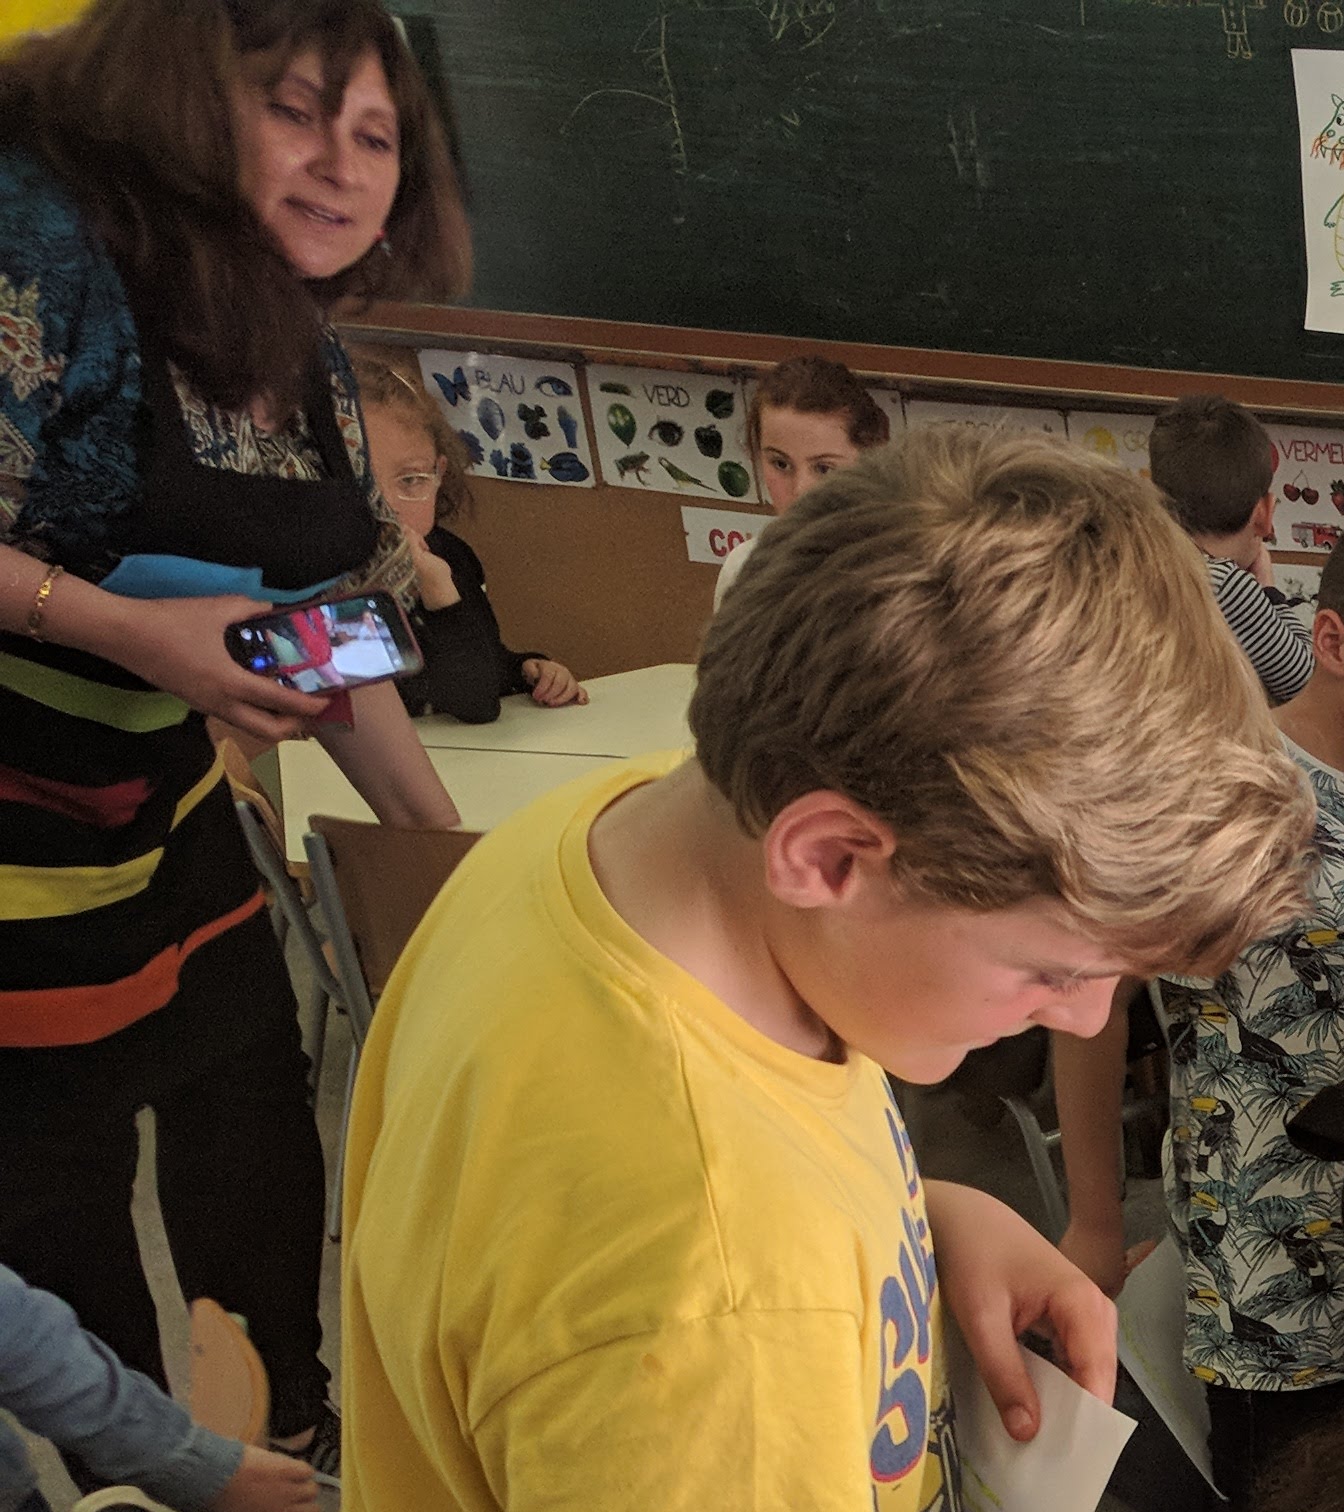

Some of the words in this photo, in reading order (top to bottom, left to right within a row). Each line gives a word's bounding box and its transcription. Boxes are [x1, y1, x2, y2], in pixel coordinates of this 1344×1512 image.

[474, 370, 525, 395] BLAU
[641, 384, 691, 408] VERD
[708, 528, 753, 557] CO
